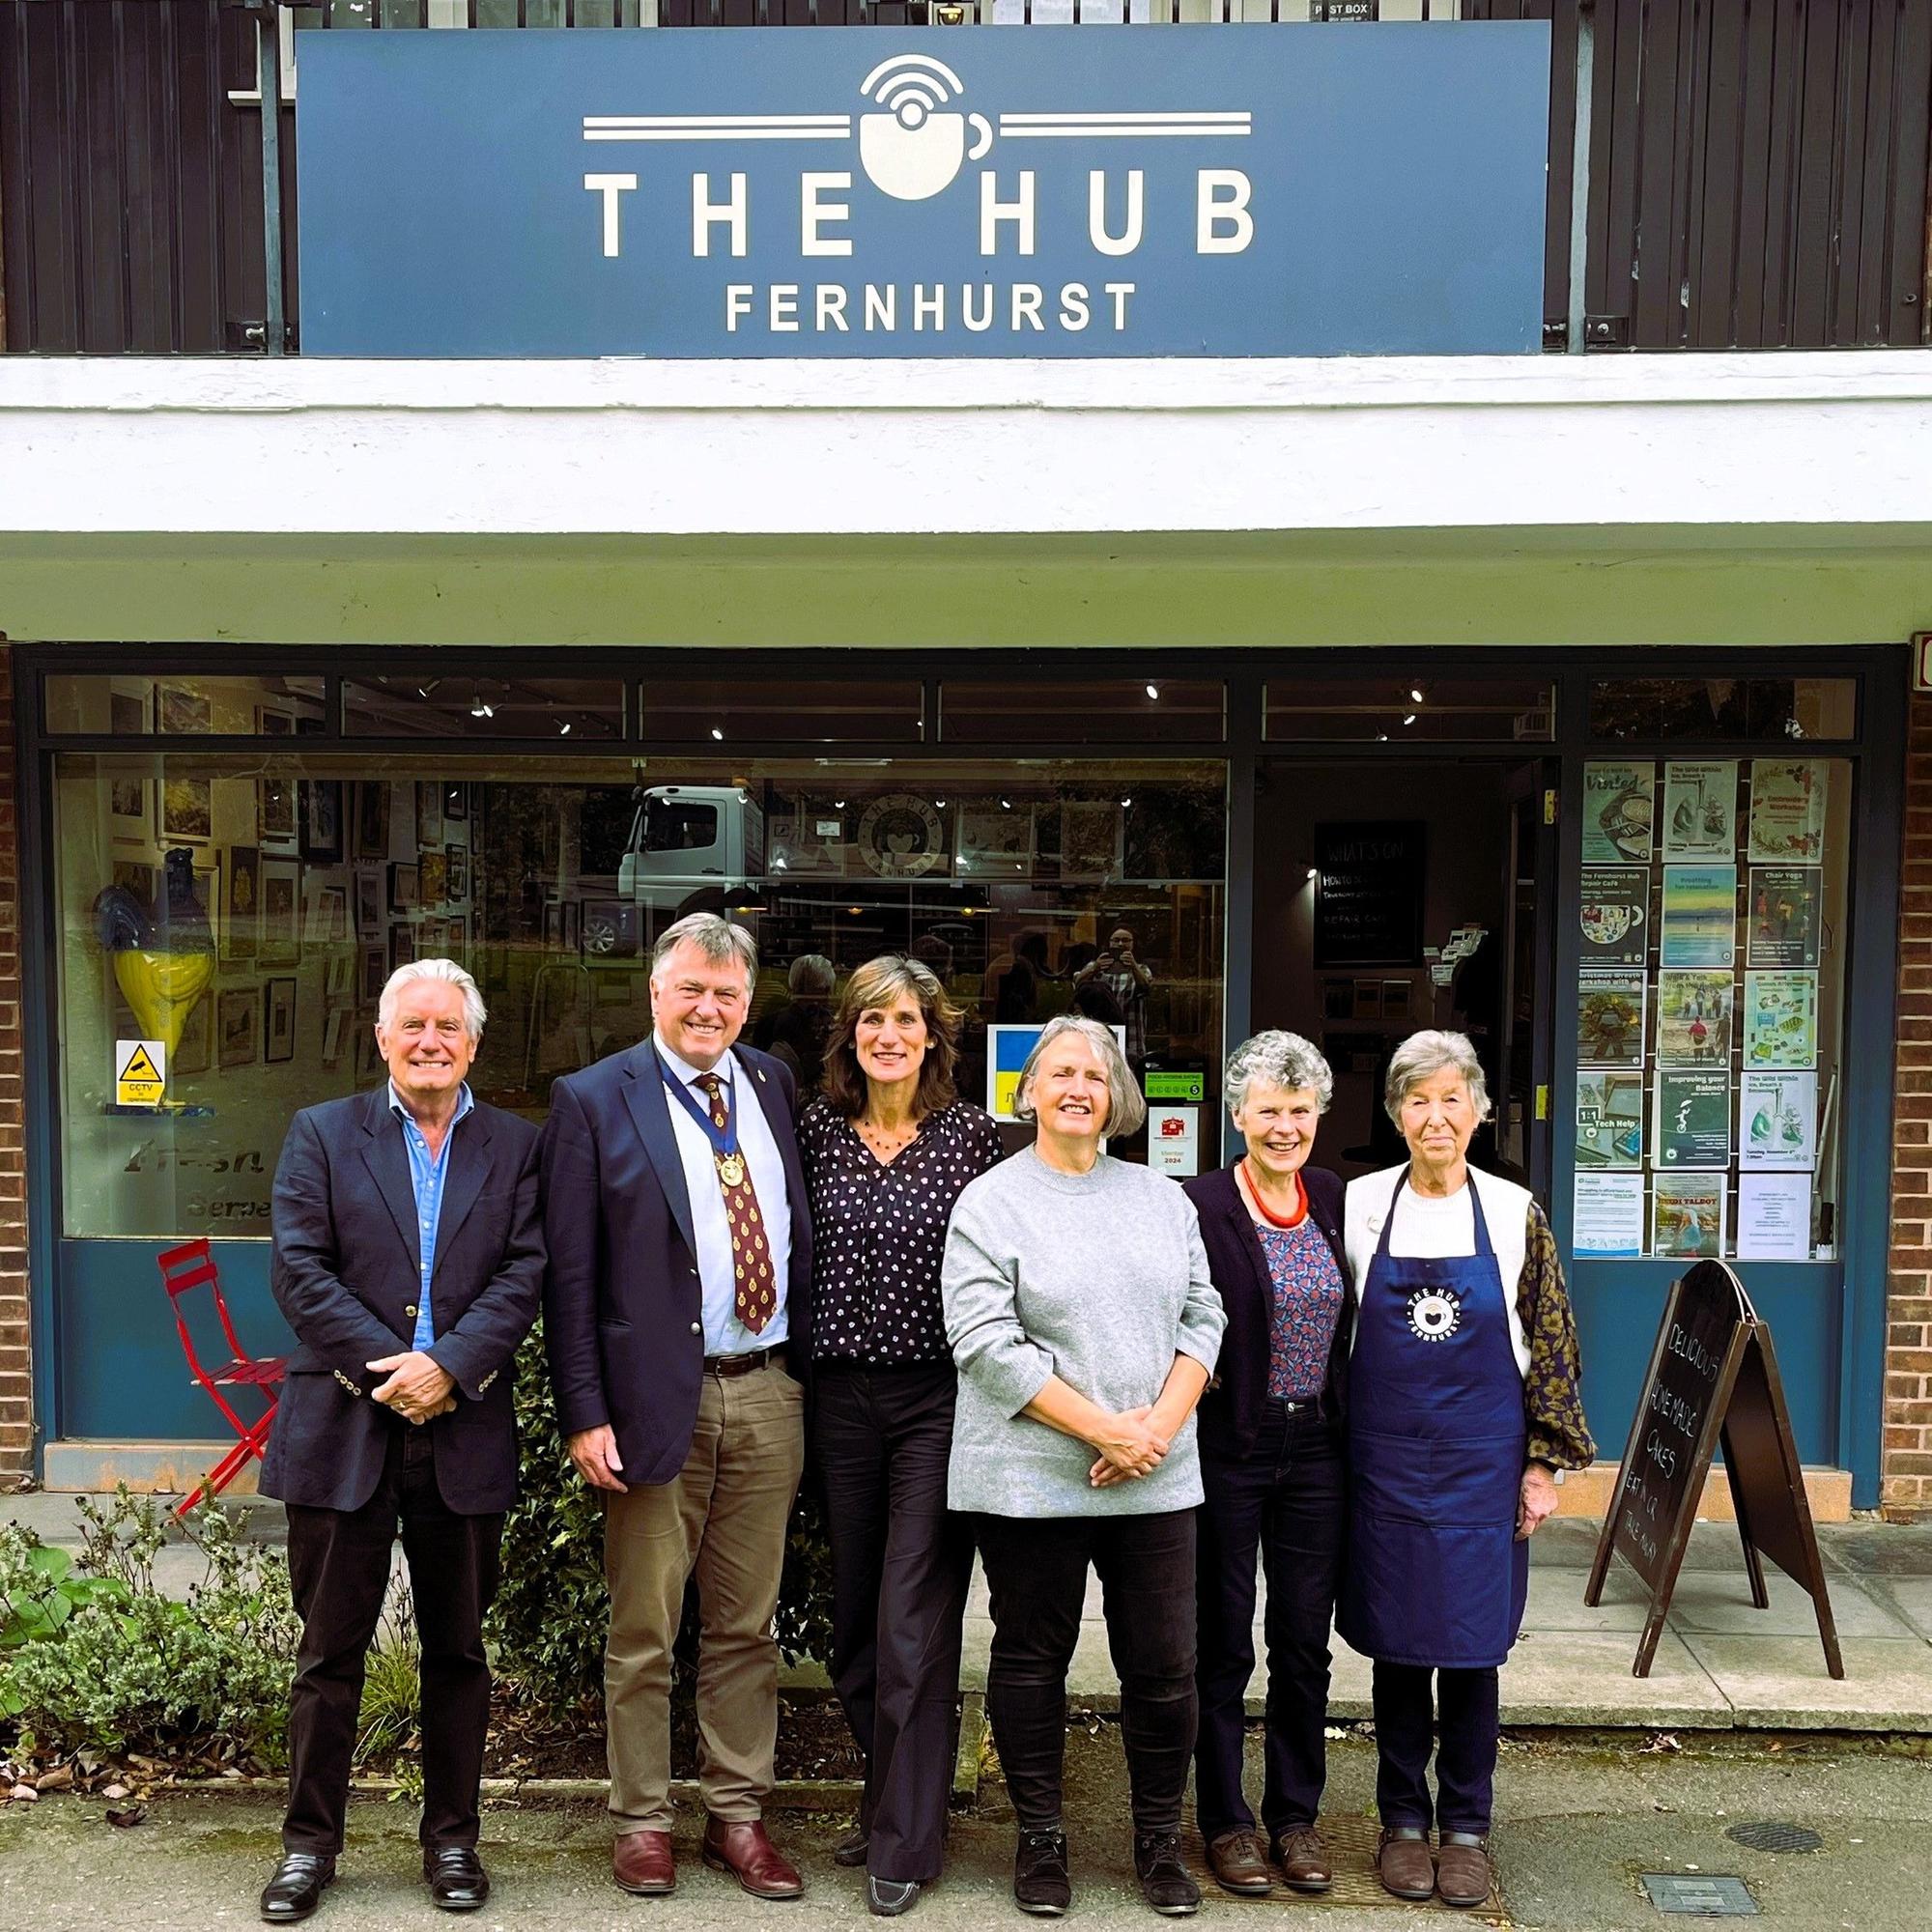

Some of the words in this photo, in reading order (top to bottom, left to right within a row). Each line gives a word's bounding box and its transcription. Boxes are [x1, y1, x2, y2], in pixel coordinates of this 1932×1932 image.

[1315, 5, 1343, 14] PST
[1346, 4, 1367, 14] BOX
[583, 172, 853, 257] THE
[980, 169, 1254, 256] HUB
[726, 282, 1136, 331] FERNHURST
[1785, 871, 1804, 880] Yoga
[128, 1083, 154, 1092] CCTV
[1668, 1074, 1707, 1083] Improving
[1580, 1111, 1597, 1121] 1:1
[1407, 1288, 1430, 1306] THE
[1668, 1323, 1719, 1382] DELICIOUS
[1646, 1429, 1676, 1479] CAKES
[1626, 1471, 1641, 1496] EAT
[1625, 1509, 1639, 1542] TAKE
